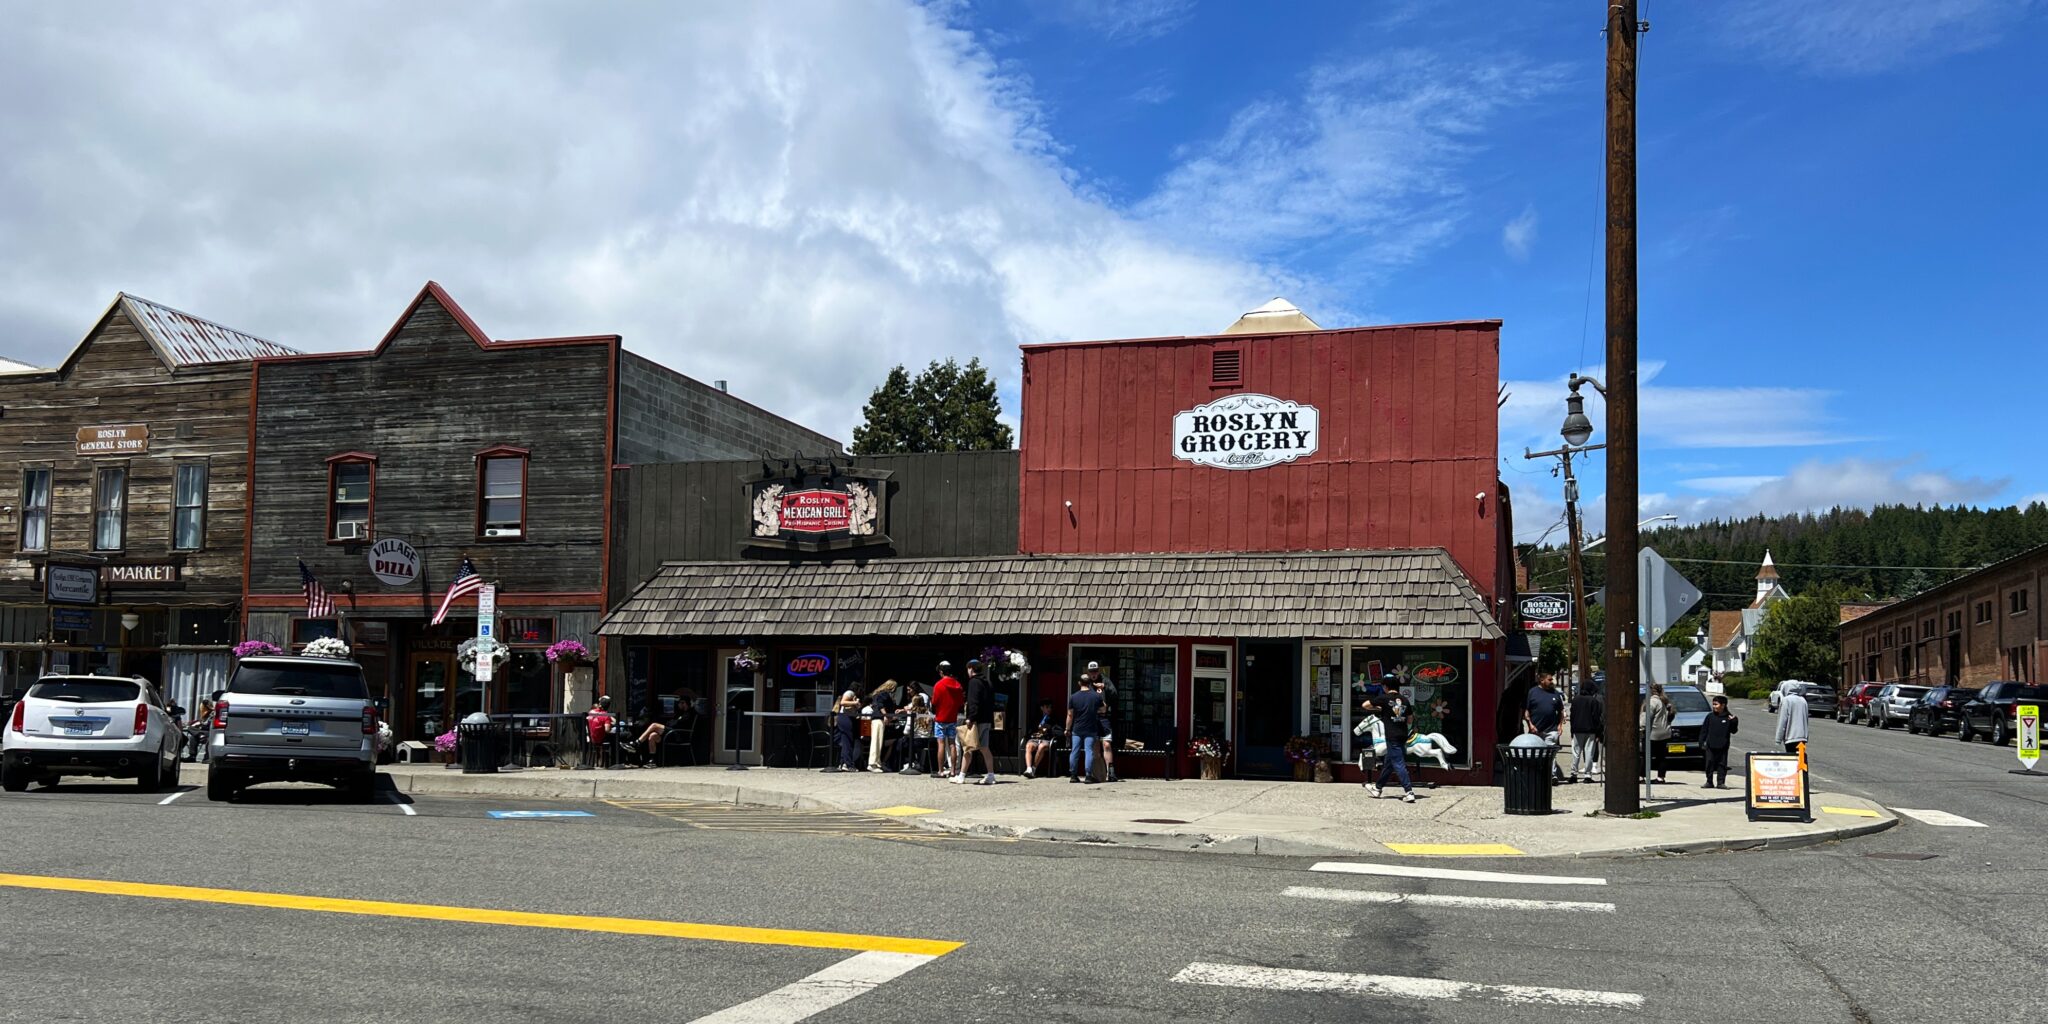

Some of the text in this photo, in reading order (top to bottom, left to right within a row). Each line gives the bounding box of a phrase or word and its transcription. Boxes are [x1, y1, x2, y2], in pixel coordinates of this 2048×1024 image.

[1192, 411, 1299, 433] ROSLYN
[97, 429, 127, 439] ROSLYN
[81, 440, 143, 450] GENERAL STORE
[1181, 430, 1311, 453] GROCERY
[783, 506, 848, 519] MEXICAN GRILL
[373, 540, 418, 565] VILLAGE
[111, 566, 174, 580] MARKET
[375, 559, 414, 577] PIZZA
[55, 583, 90, 594] Mercantile
[790, 658, 825, 673] OPEN
